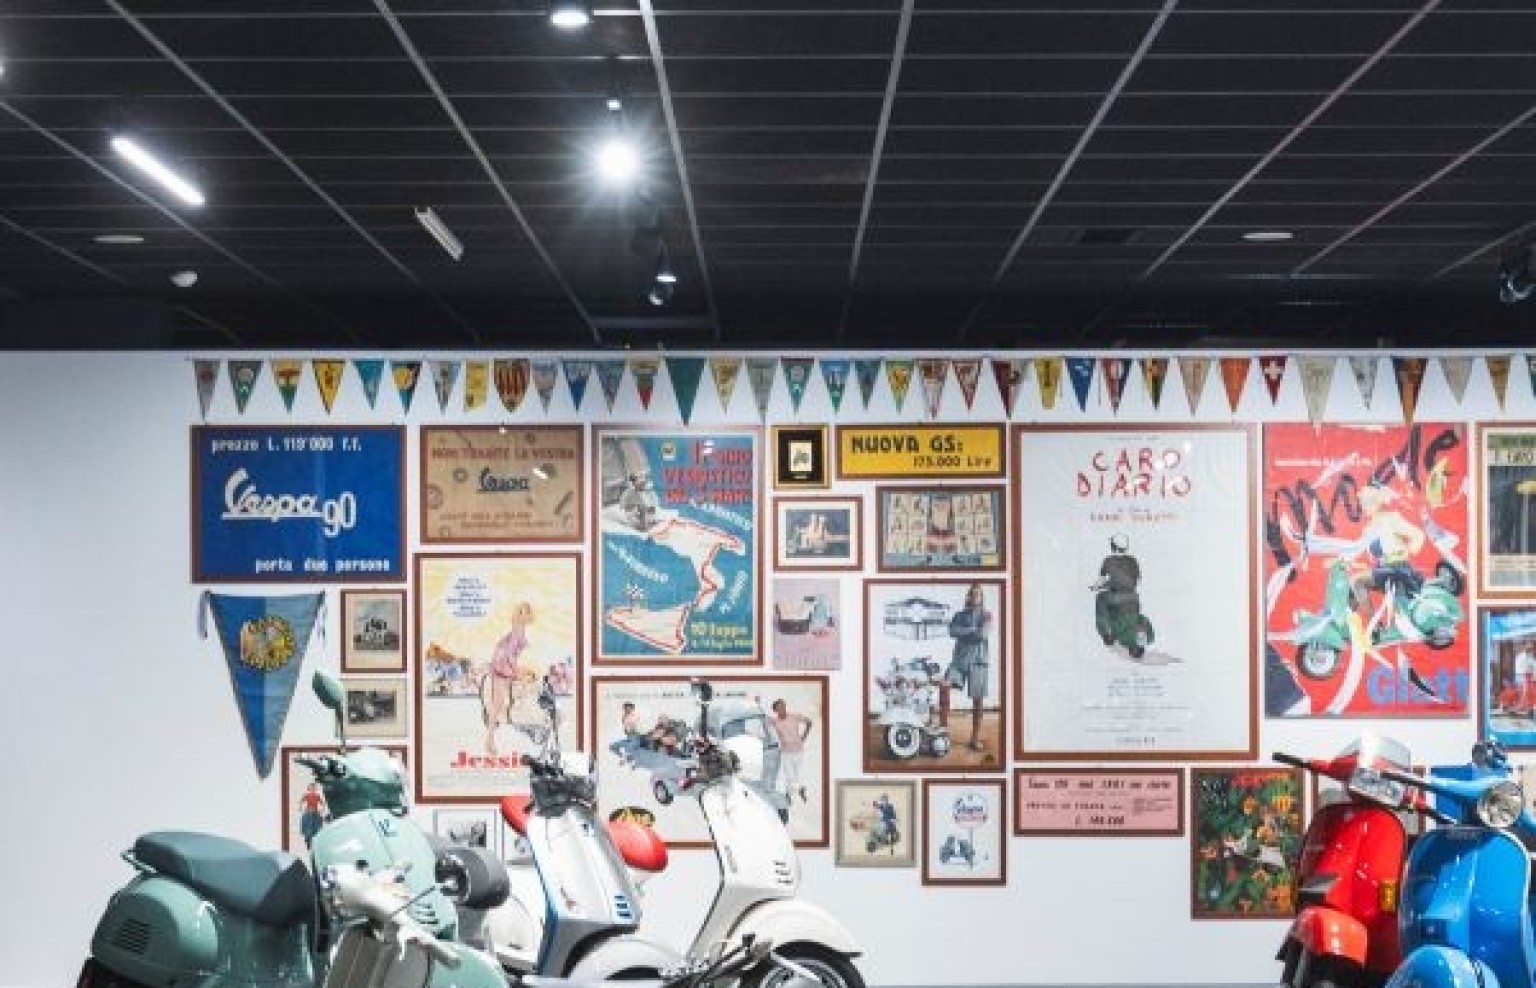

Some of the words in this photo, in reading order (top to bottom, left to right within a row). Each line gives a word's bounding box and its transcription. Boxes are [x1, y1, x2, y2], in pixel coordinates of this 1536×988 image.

[212, 439, 260, 454] prezzo
[851, 435, 920, 453] NUOVA
[928, 435, 964, 453] GS:
[967, 454, 992, 466] Lire
[1092, 447, 1182, 472] CARO
[477, 466, 530, 493] Vespa
[1076, 472, 1192, 497] DIARIO
[221, 467, 324, 522] Vespa
[322, 491, 356, 538] 90
[255, 558, 293, 574] porta
[304, 558, 329, 572] due
[335, 558, 390, 574] persone
[451, 752, 530, 768] Jessi
